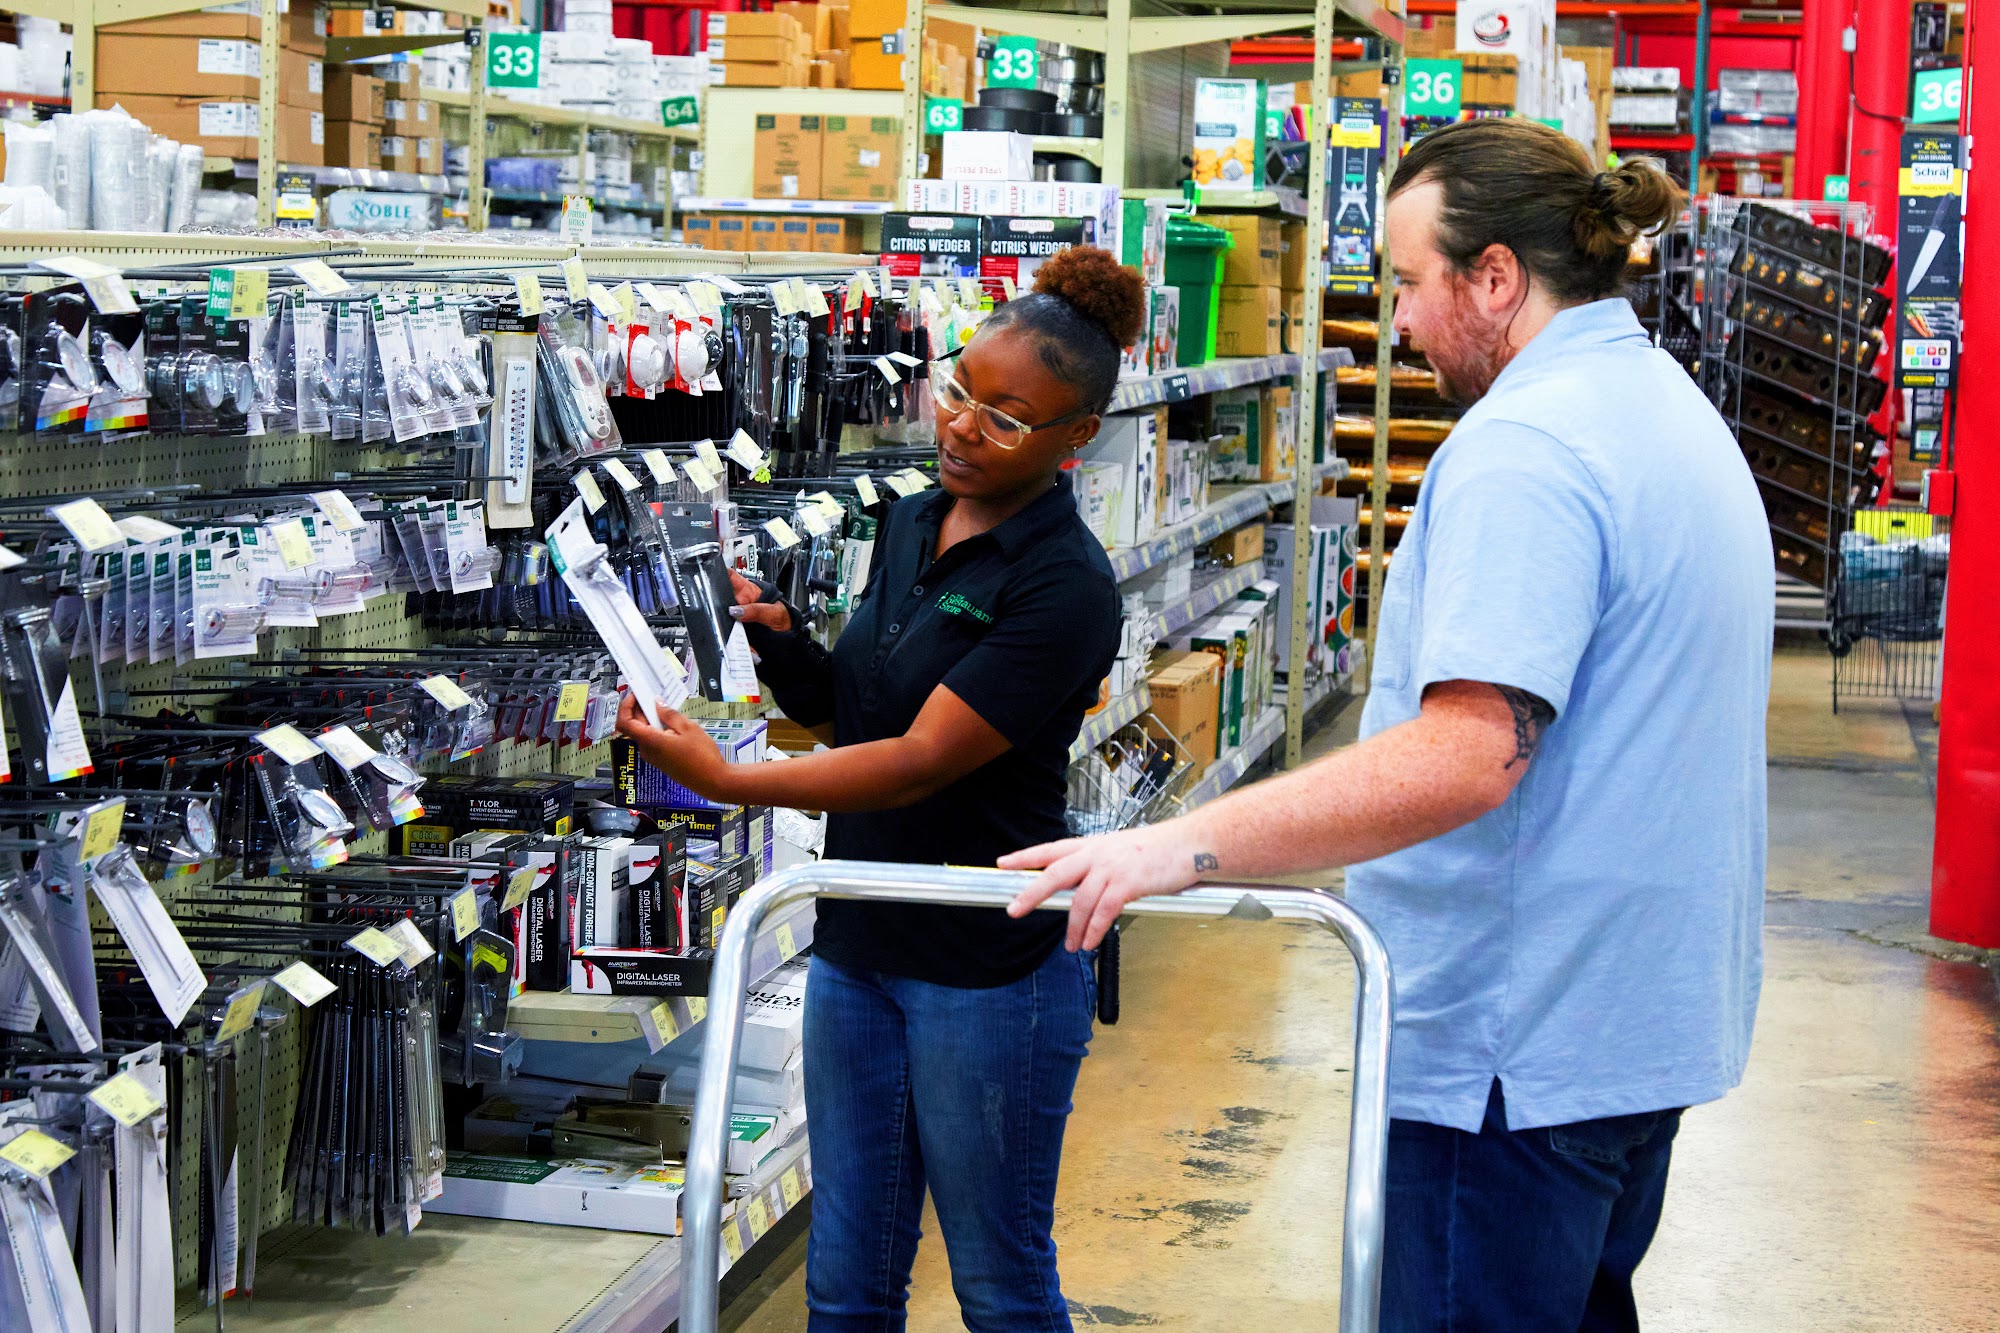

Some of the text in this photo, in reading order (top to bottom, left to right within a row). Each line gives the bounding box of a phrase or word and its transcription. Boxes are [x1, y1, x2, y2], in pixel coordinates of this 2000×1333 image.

[886, 44, 893, 53] 3
[492, 45, 534, 77] 33
[992, 48, 1034, 80] 33
[1410, 71, 1455, 104] 36
[1921, 80, 1962, 111] 36
[665, 101, 693, 121] 64
[929, 105, 959, 128] 63
[1265, 117, 1279, 137] 3
[1828, 180, 1849, 199] 60
[353, 203, 411, 219] NOBLE
[890, 237, 971, 253] CITRUS WEDGER
[991, 240, 1027, 254] CITRUS
[212, 276, 233, 292] New
[210, 293, 231, 309] item
[1171, 377, 1187, 388] BIN
[1178, 387, 1185, 397] 1
[658, 517, 691, 608] MEAT THERMOMETER
[747, 545, 756, 573] ARDE
[939, 602, 962, 615] Store
[945, 594, 994, 625] Restaurant
[618, 765, 628, 791] 4-in-1
[626, 744, 636, 805] Digital Timer
[670, 812, 695, 822] 4-in-1
[689, 822, 715, 831] Timer
[586, 848, 595, 909] NON-CONTACT
[535, 933, 543, 962] LASER
[616, 972, 681, 982] DIGITAL LASER
[747, 990, 802, 1003] NUAL
